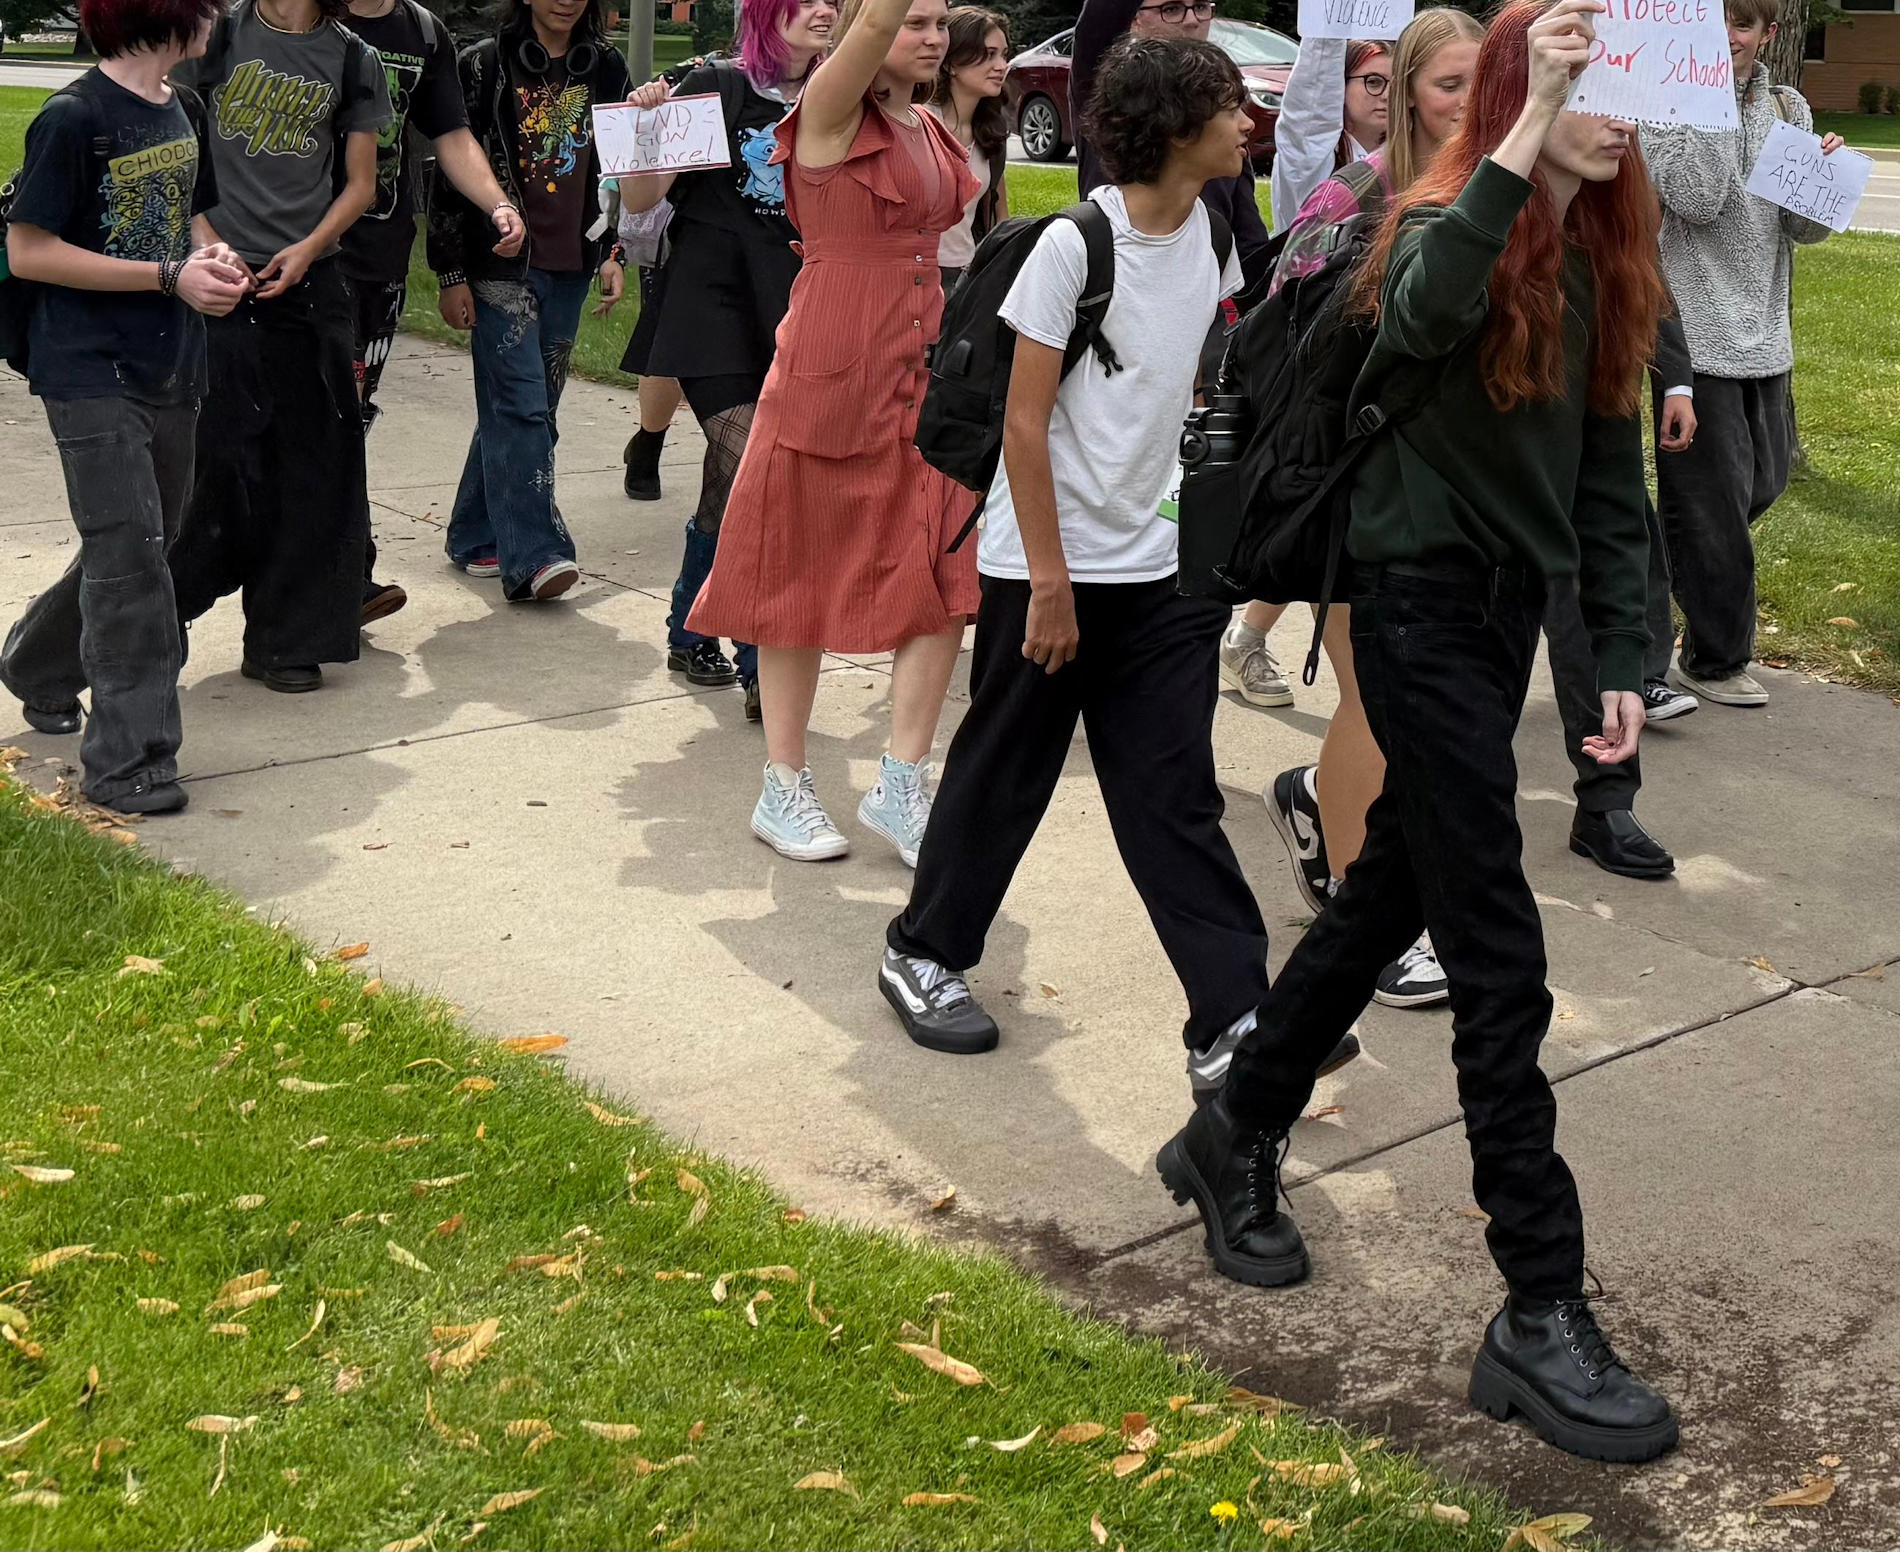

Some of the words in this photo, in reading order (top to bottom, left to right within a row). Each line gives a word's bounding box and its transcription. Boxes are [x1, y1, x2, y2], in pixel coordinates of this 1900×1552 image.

[1660, 39, 1729, 94] Schools!
[636, 104, 692, 134] END
[636, 126, 689, 147] GUN
[605, 136, 714, 173] Violence!
[1784, 144, 1837, 181] GUNS
[1768, 165, 1809, 199] ARE
[1815, 184, 1847, 215] THE
[1783, 195, 1834, 226] PROBLEM
